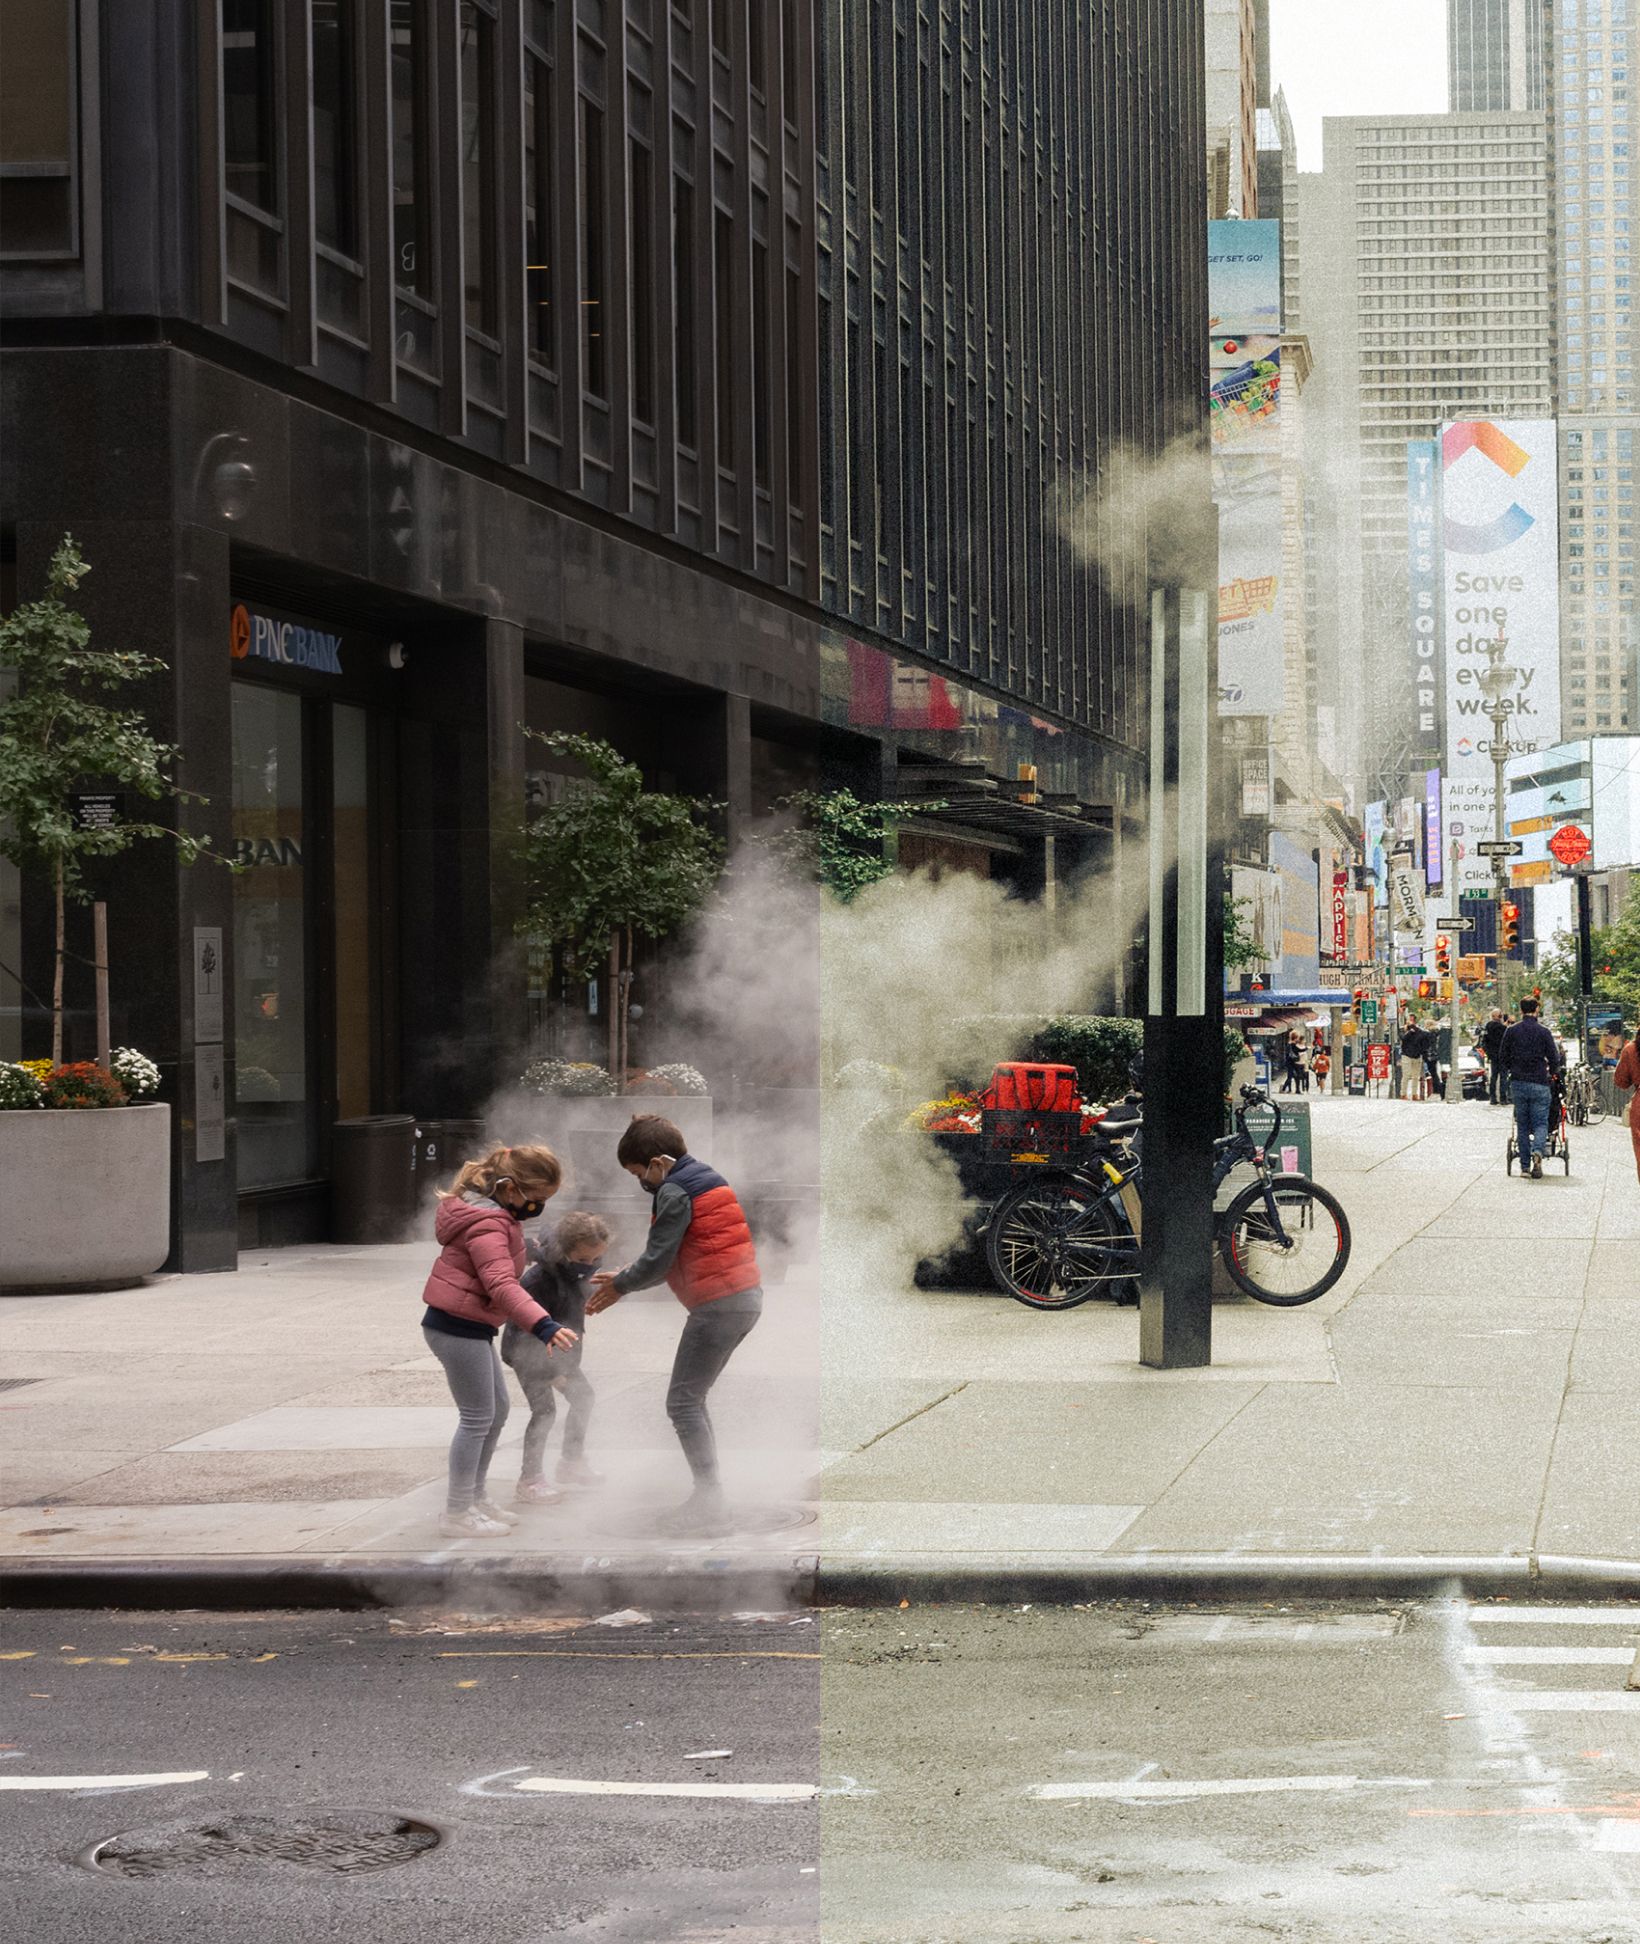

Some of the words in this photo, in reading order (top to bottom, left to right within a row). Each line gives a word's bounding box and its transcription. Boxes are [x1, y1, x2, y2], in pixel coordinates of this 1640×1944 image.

[1246, 254, 1264, 262] GO!
[1412, 457, 1433, 572] TIMES
[1455, 571, 1524, 593] Save
[1455, 606, 1508, 624] one
[293, 624, 343, 674] BANK
[1455, 632, 1509, 660] day
[1415, 591, 1435, 731] SQUARE
[1456, 667, 1536, 690] evy
[1456, 693, 1538, 716] week.
[1450, 785, 1464, 795] All
[1466, 784, 1480, 795] of
[1482, 786, 1508, 797] yor
[1449, 803, 1460, 812] in
[1463, 803, 1486, 812] one
[1468, 825, 1494, 833] Tasks
[232, 837, 304, 867] BAN
[1464, 869, 1500, 880] ClickU
[1472, 889, 1480, 898] 53
